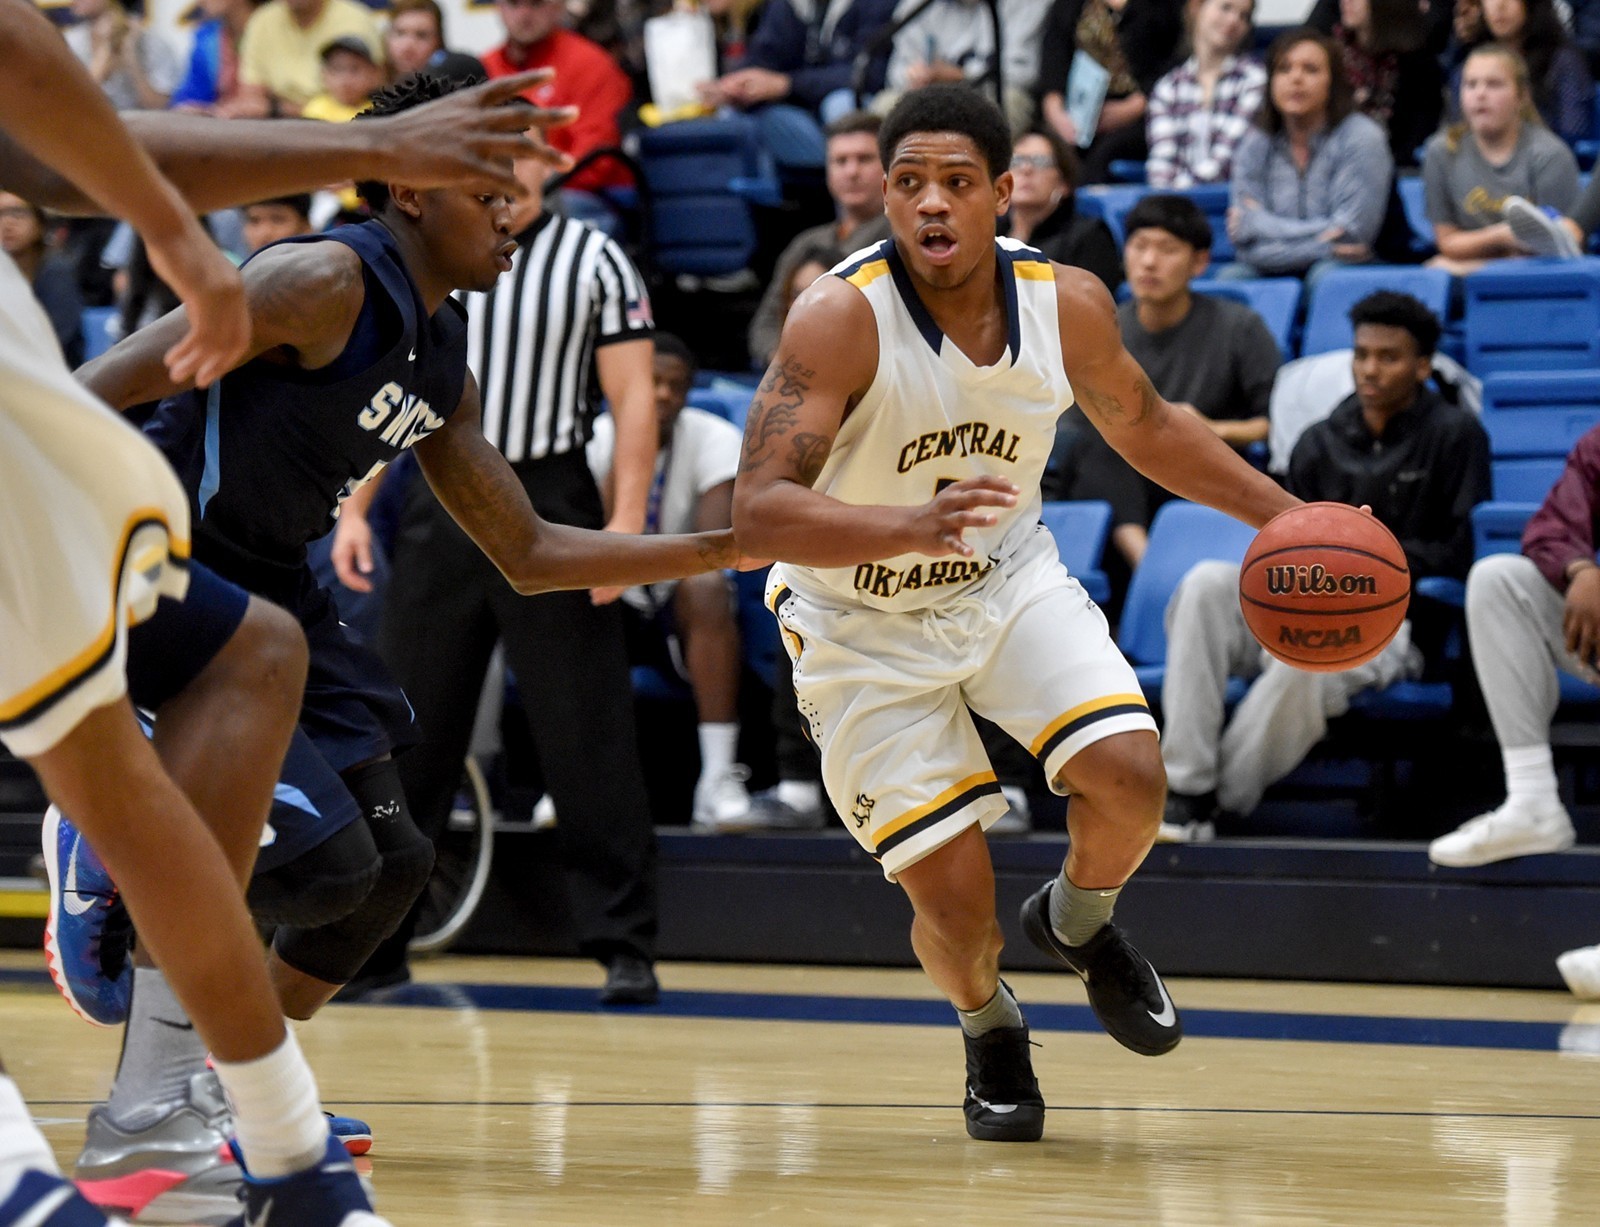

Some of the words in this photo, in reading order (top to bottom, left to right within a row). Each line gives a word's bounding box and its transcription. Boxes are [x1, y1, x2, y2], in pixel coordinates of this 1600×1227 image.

[897, 422, 1021, 473] CENTRAL
[1265, 563, 1379, 597] Wilson
[1278, 625, 1363, 649] NCAA
